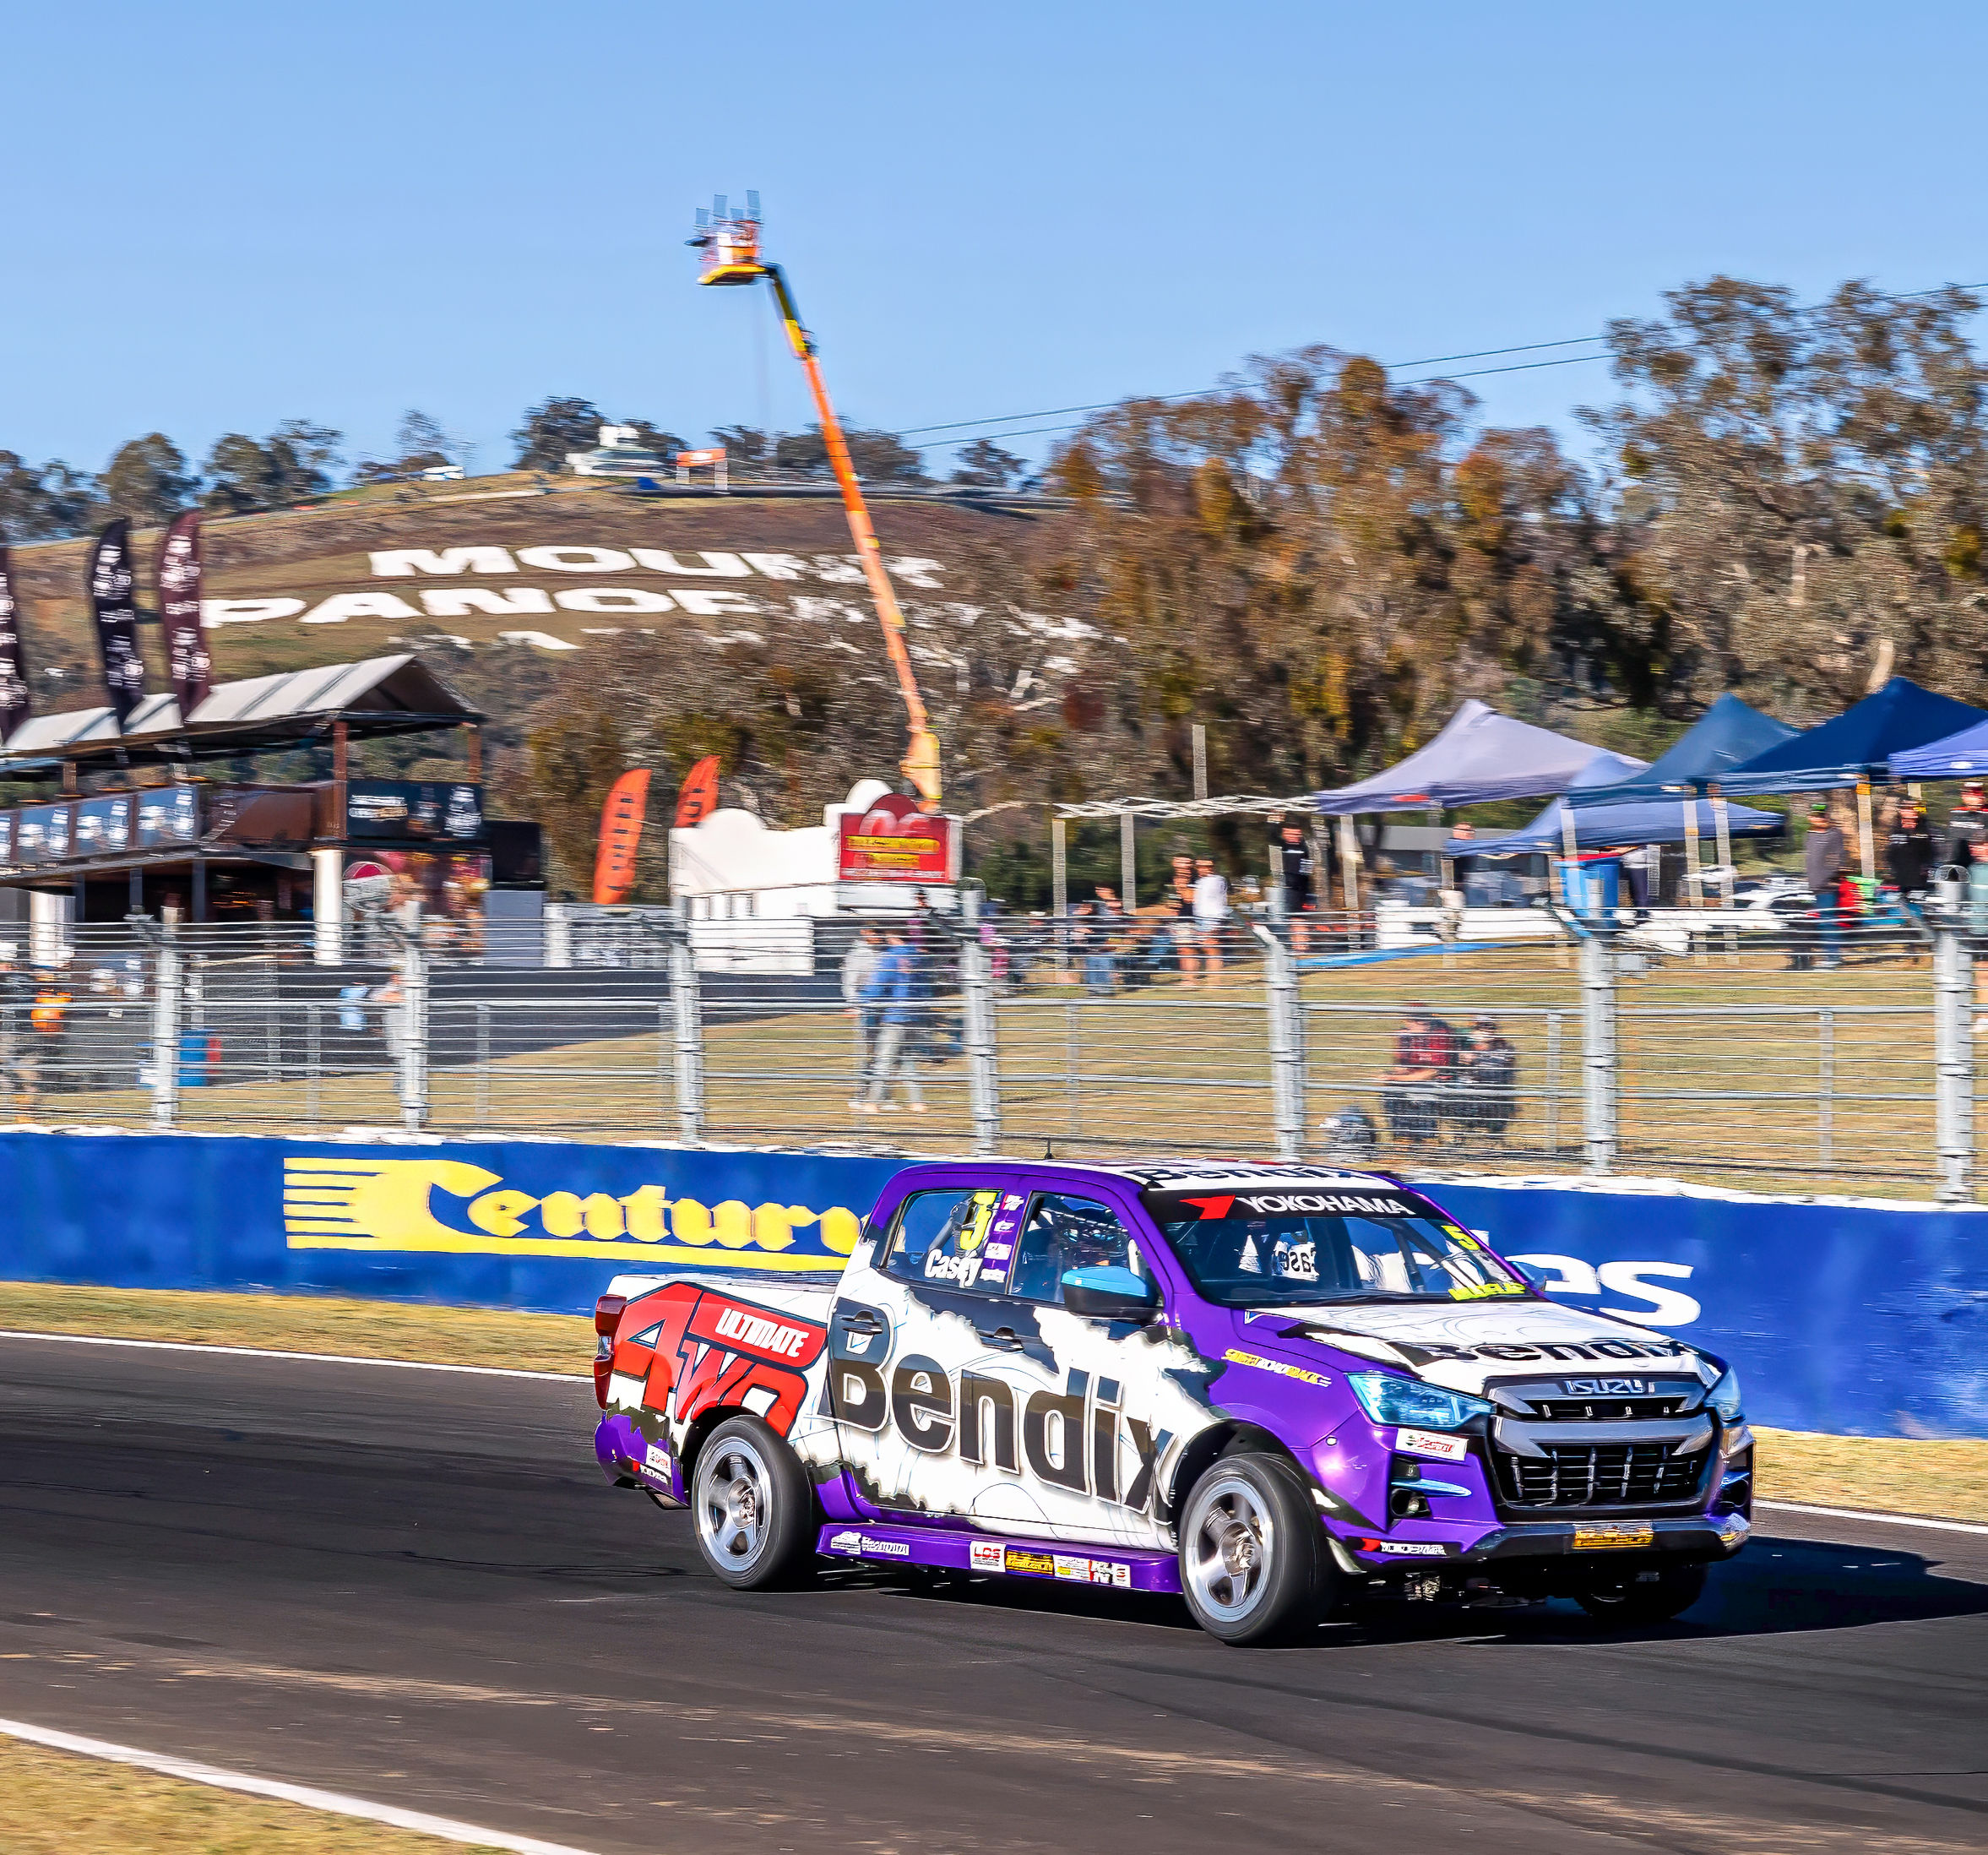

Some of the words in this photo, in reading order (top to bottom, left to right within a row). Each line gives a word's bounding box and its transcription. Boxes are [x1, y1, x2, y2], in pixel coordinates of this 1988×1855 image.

[369, 544, 942, 589] MOU
[1236, 1194, 1416, 1216] YOKOHAMA
[714, 1308, 809, 1357] ULTIMATE
[817, 1297, 1174, 1524] Bendix
